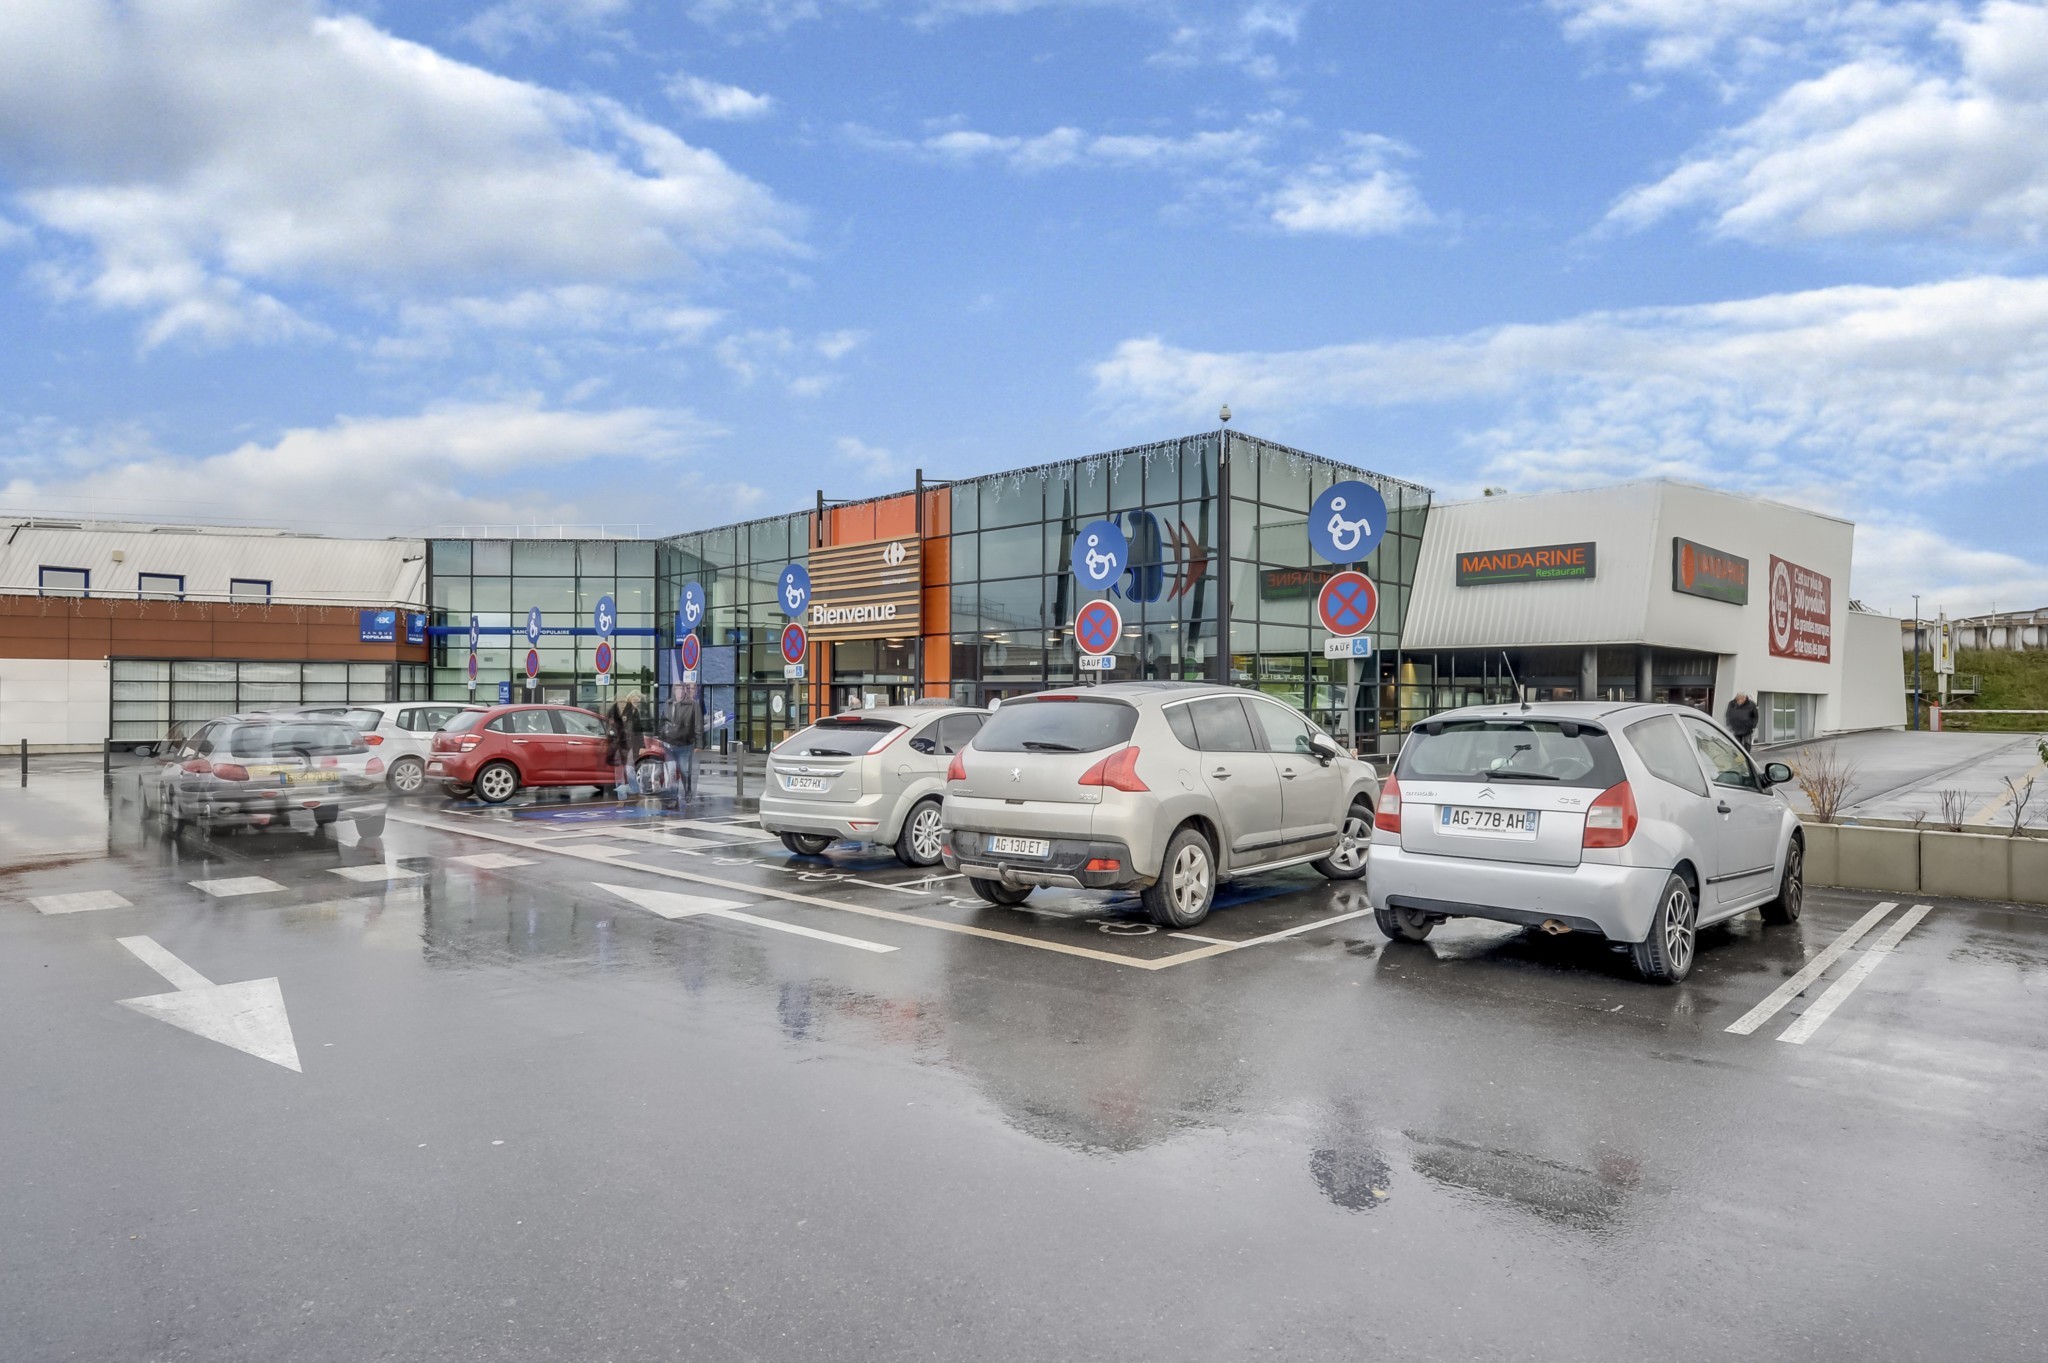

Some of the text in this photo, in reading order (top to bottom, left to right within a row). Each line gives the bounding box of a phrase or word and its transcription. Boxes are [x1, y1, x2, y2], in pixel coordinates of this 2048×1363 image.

[1462, 548, 1586, 573] MANDARINE
[1535, 566, 1586, 578] Restaurant
[1794, 587, 1826, 616] 500 produits
[813, 603, 896, 625] Bienvenue
[1329, 643, 1350, 652] SAUF
[1081, 659, 1101, 667] SAUF
[1452, 810, 1525, 830] AG-778-AH
[1526, 821, 1535, 830] 59
[995, 836, 1042, 854] AG-130-ET
